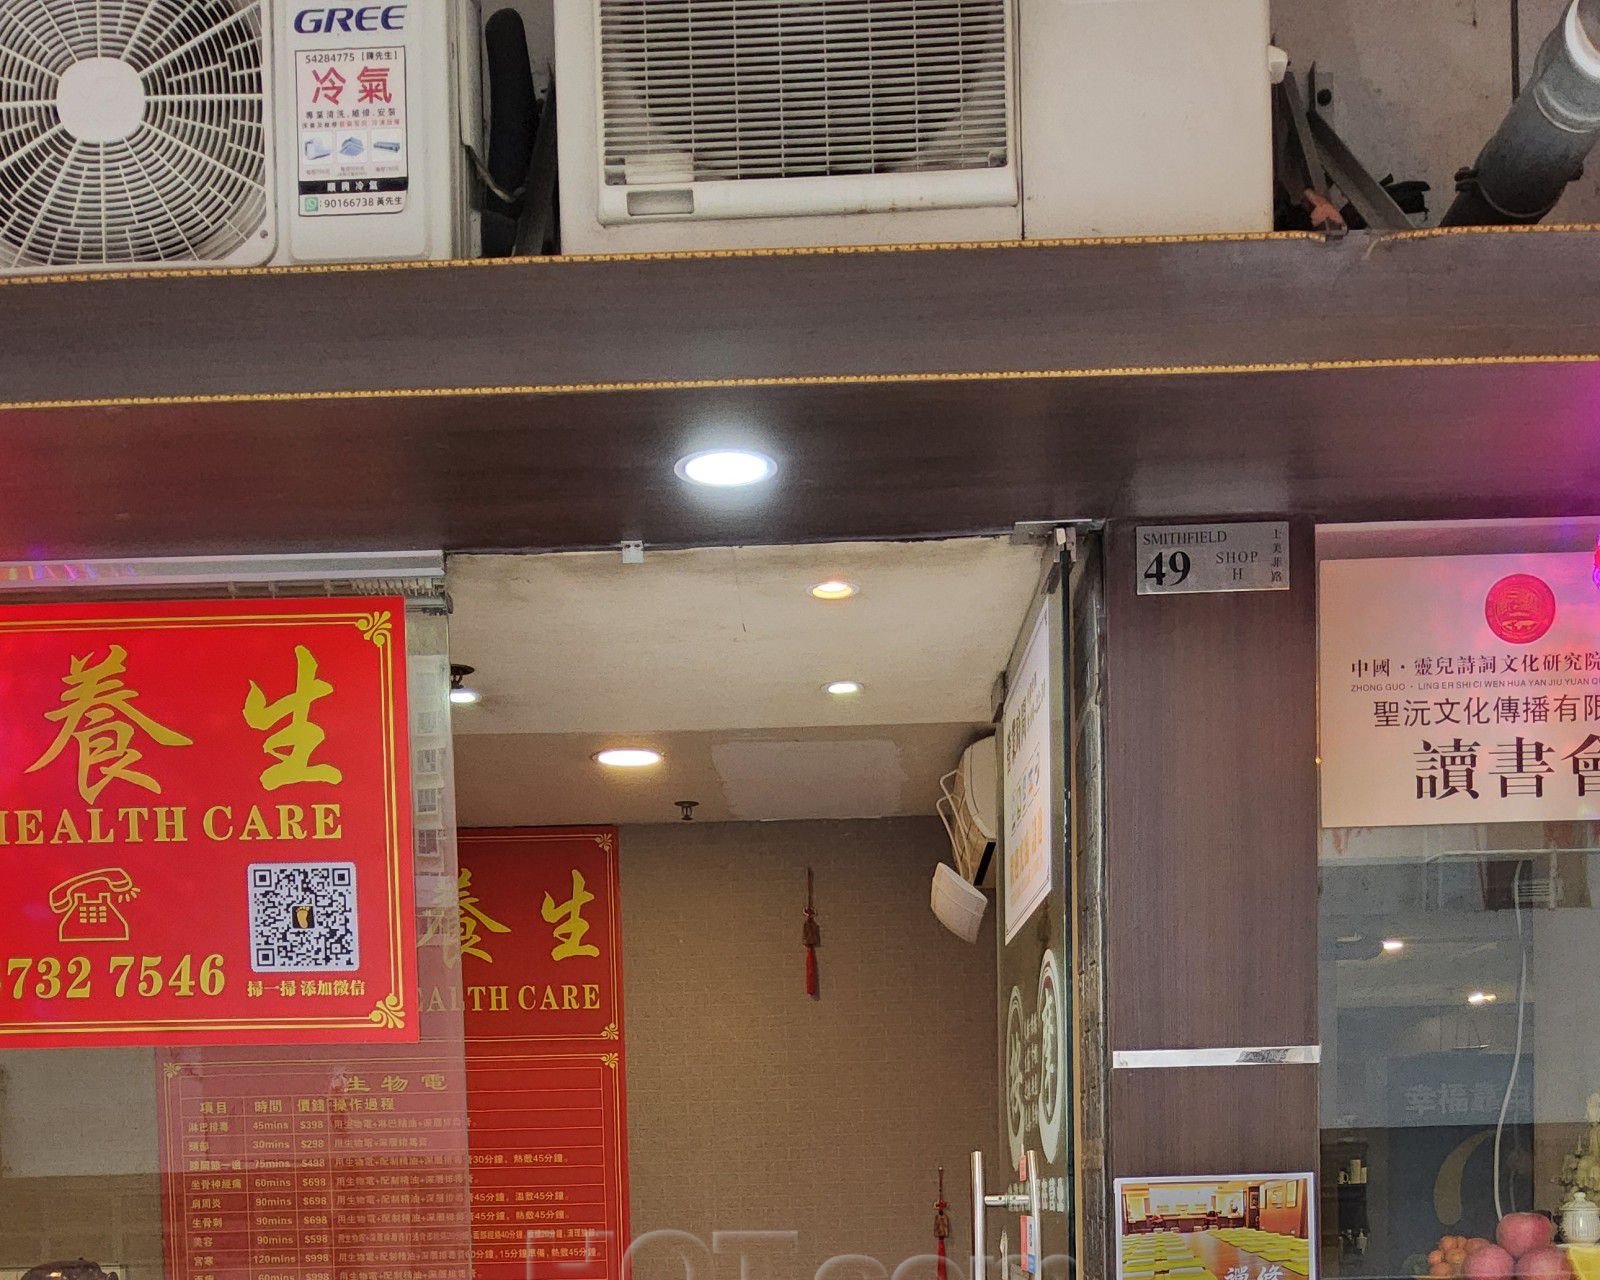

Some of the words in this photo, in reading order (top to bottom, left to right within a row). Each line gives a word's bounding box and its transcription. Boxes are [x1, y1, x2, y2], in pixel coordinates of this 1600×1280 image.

[294, 5, 407, 33] GREE
[305, 53, 355, 64] 54284775
[312, 66, 393, 105] 冷氣
[1143, 530, 1228, 546] SMITHFIELD
[1215, 551, 1259, 564] SHOP
[1143, 551, 1191, 586] 49
[1232, 568, 1243, 581] H
[1351, 683, 1383, 692] ZHONG
[1385, 683, 1406, 691] GUO
[1418, 682, 1440, 690] LING
[1456, 681, 1472, 689] SHI
[1484, 680, 1505, 688] WEN
[1549, 678, 1563, 686] JIU
[24, 644, 344, 805] 養生
[0, 807, 188, 845] EALTH
[203, 803, 343, 841] CARE
[0, 957, 92, 999] 732
[109, 954, 226, 998] 7546
[518, 984, 601, 1011] CARE
[254, 1099, 283, 1113] 時間
[300, 1120, 324, 1130] $398
[253, 1140, 290, 1149] 30mins
[301, 1139, 325, 1149] $298
[255, 1178, 291, 1188] 60mins
[302, 1178, 326, 1187] $698
[256, 1198, 292, 1207] 90mins
[303, 1196, 327, 1206] $698
[256, 1217, 293, 1226] 90mins
[303, 1215, 327, 1225] $698
[257, 1235, 294, 1245] 90mins
[304, 1234, 328, 1244] $598
[253, 1254, 296, 1264] 120mins
[305, 1253, 329, 1263] $998
